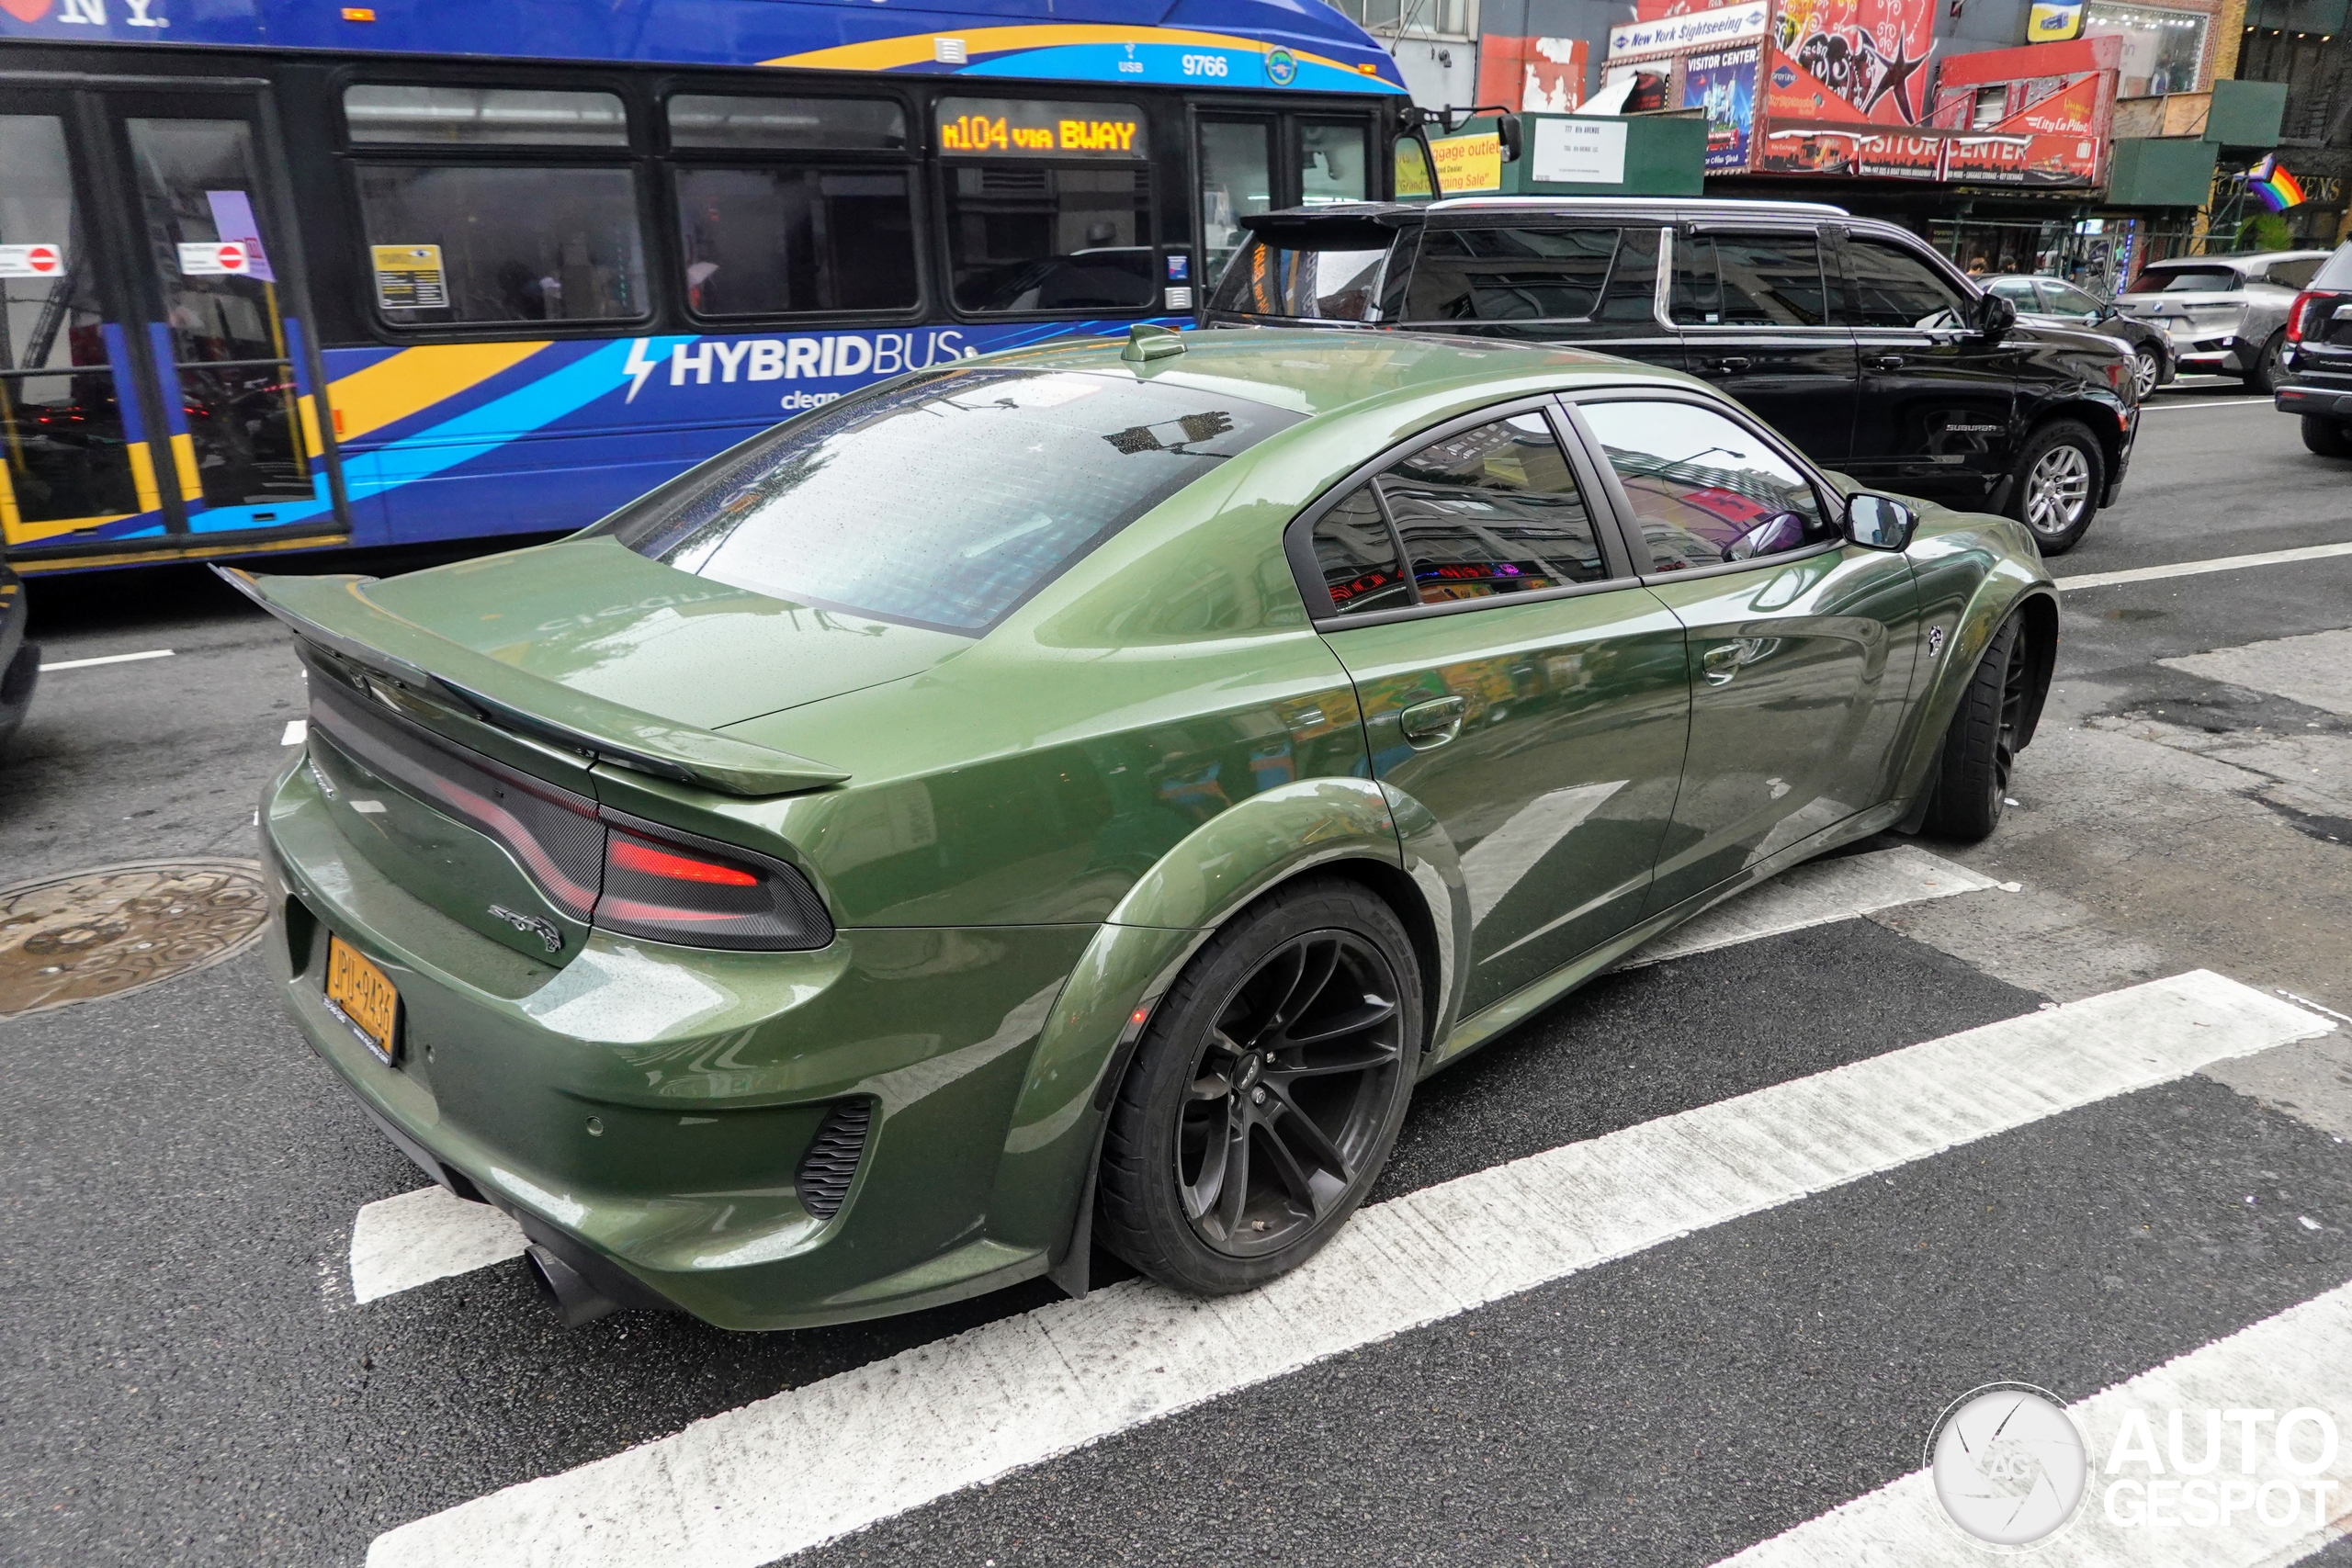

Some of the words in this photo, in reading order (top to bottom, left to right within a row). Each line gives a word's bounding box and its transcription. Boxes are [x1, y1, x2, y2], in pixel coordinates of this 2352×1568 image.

[1631, 31, 1653, 48] New
[1655, 27, 1676, 43] York
[1679, 17, 1743, 41] Sightseeing
[1118, 61, 1144, 73] USB
[1182, 53, 1228, 77] 9766
[1688, 54, 1721, 73] VISITOR
[1722, 49, 1757, 67] CENTER
[1058, 119, 1136, 150] BWAY
[1584, 126, 1600, 134] AVENUE
[2036, 116, 2055, 133] City
[1467, 140, 1501, 157] outlet
